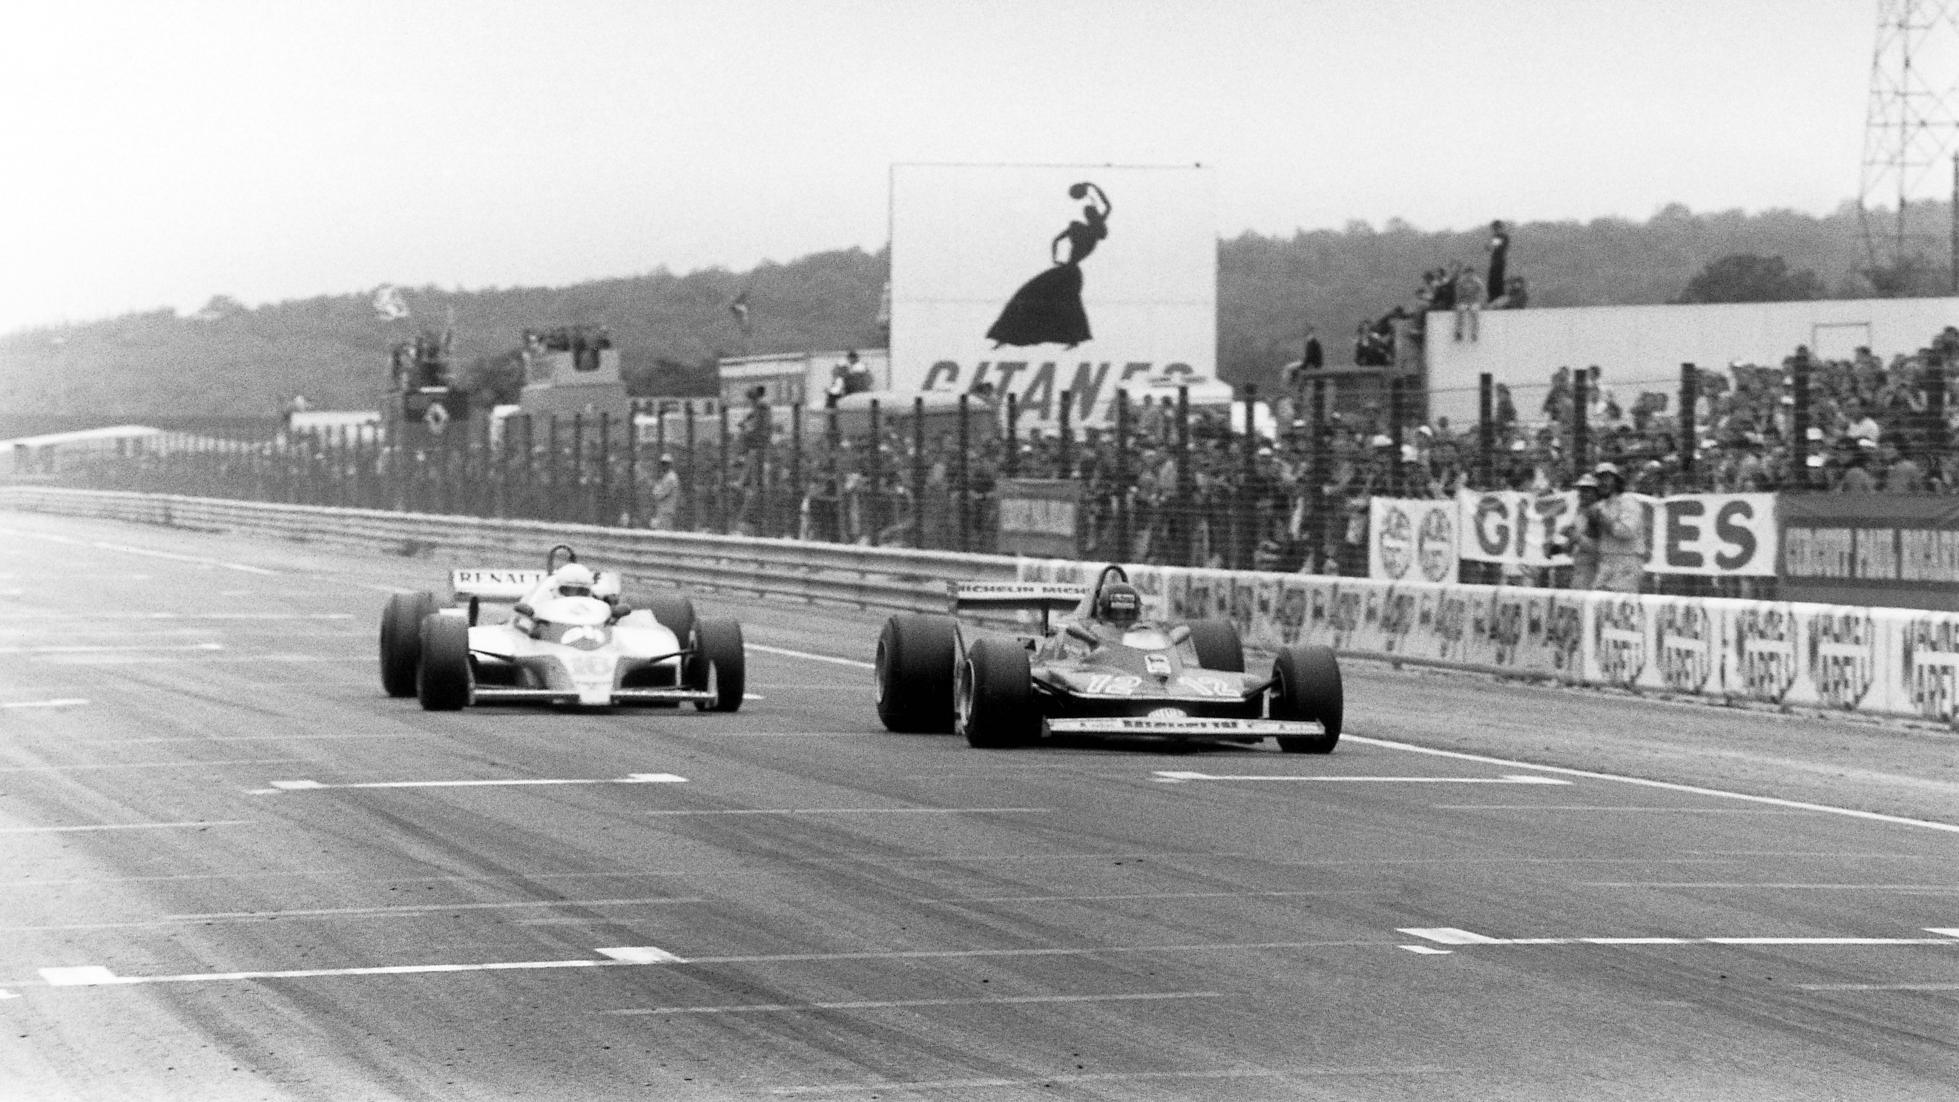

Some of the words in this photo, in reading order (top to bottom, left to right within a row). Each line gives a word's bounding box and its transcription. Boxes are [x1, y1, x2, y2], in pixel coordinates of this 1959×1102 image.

[1475, 495, 1757, 570] GITES
[1042, 586, 1090, 595] MICH
[1087, 674, 1143, 696] 12
[1178, 675, 1242, 697] 12
